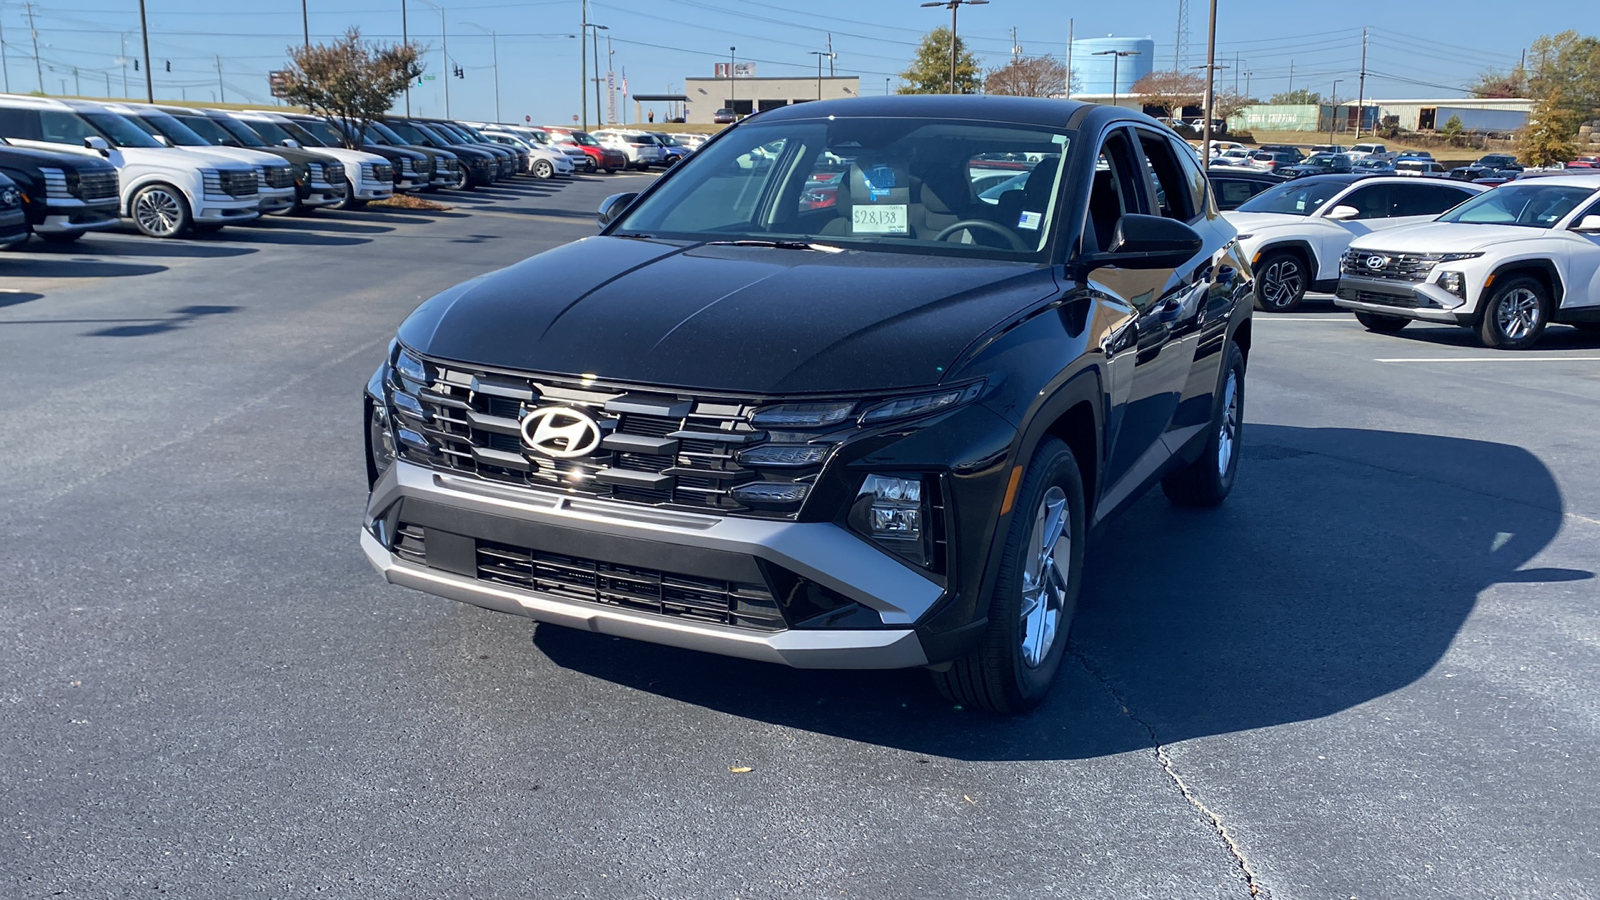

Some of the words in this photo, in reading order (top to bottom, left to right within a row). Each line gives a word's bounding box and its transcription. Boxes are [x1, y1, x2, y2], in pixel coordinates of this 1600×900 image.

[1247, 113, 1265, 123] CHINA
[1268, 113, 1297, 123] SHIPPING
[854, 210, 896, 225] $28,138
